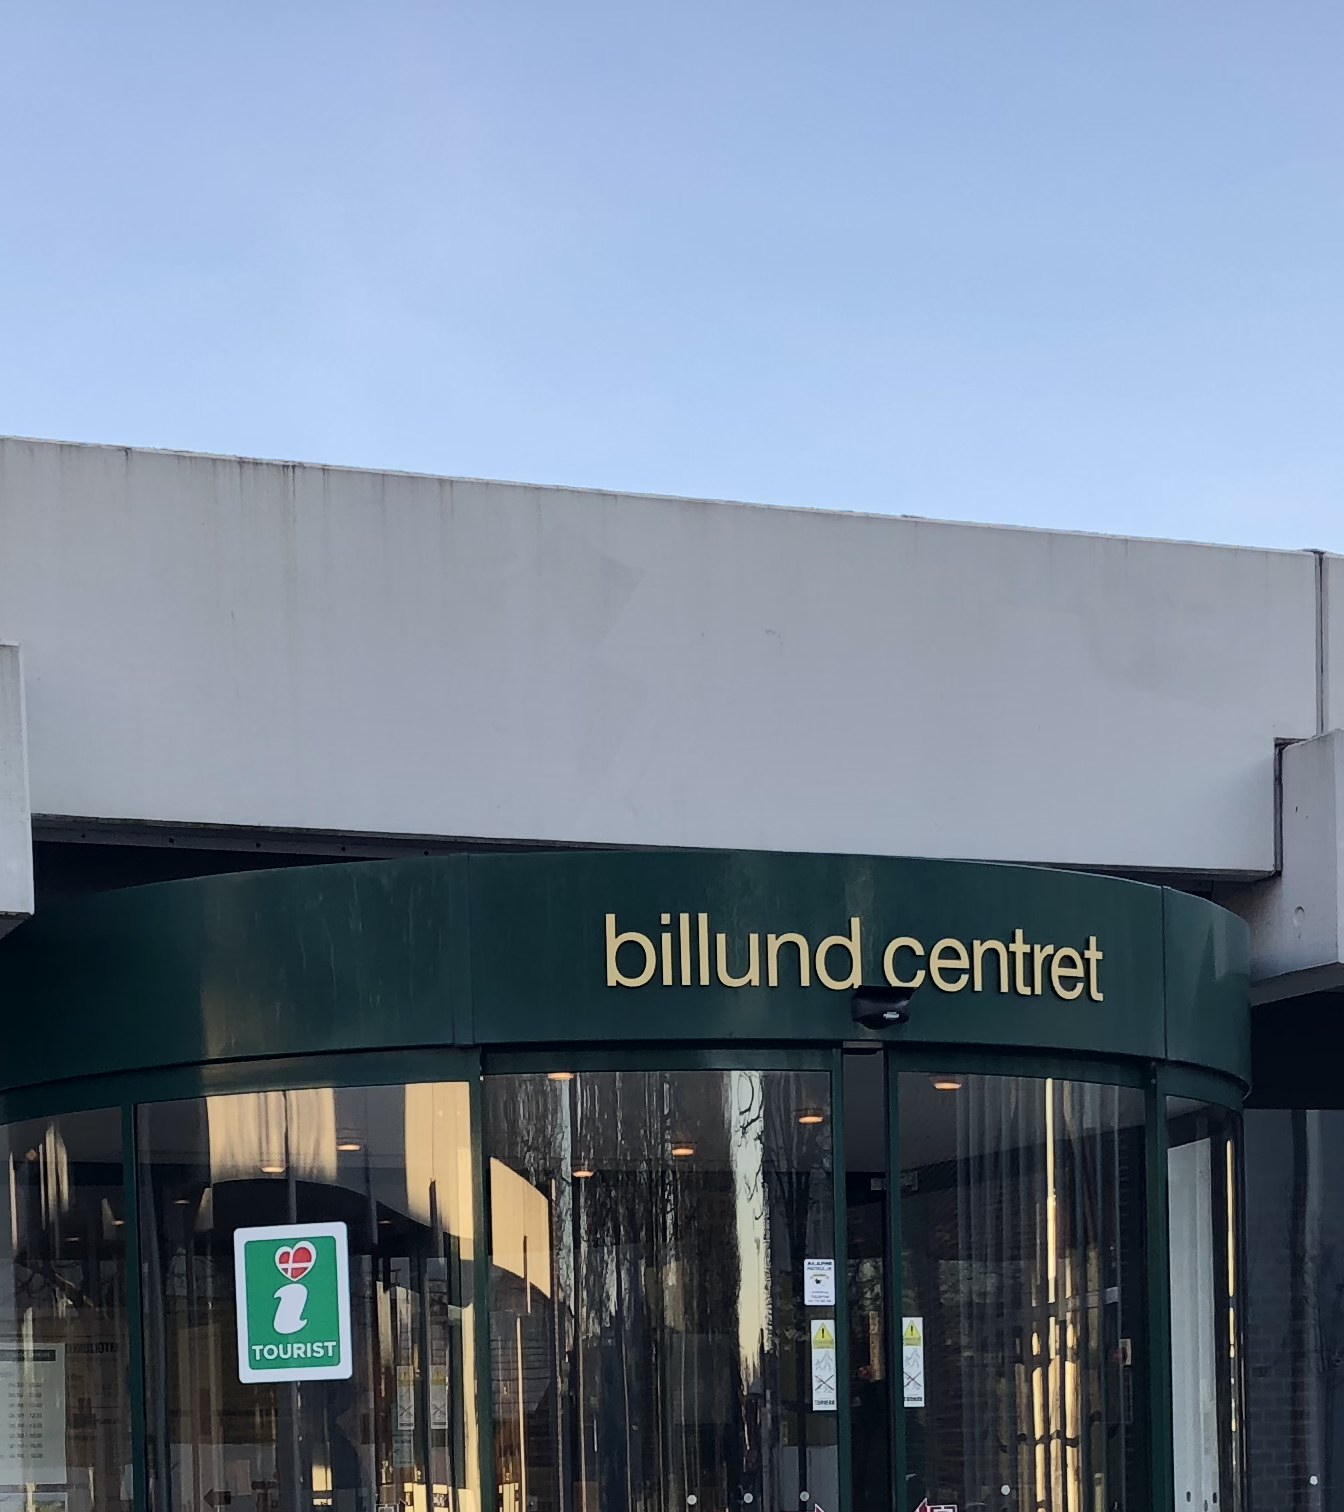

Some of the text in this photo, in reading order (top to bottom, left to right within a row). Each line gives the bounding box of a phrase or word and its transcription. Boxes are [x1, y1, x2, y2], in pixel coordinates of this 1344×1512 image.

[606, 913, 1104, 1002] billund centret
[252, 1341, 337, 1361] TOURIST
